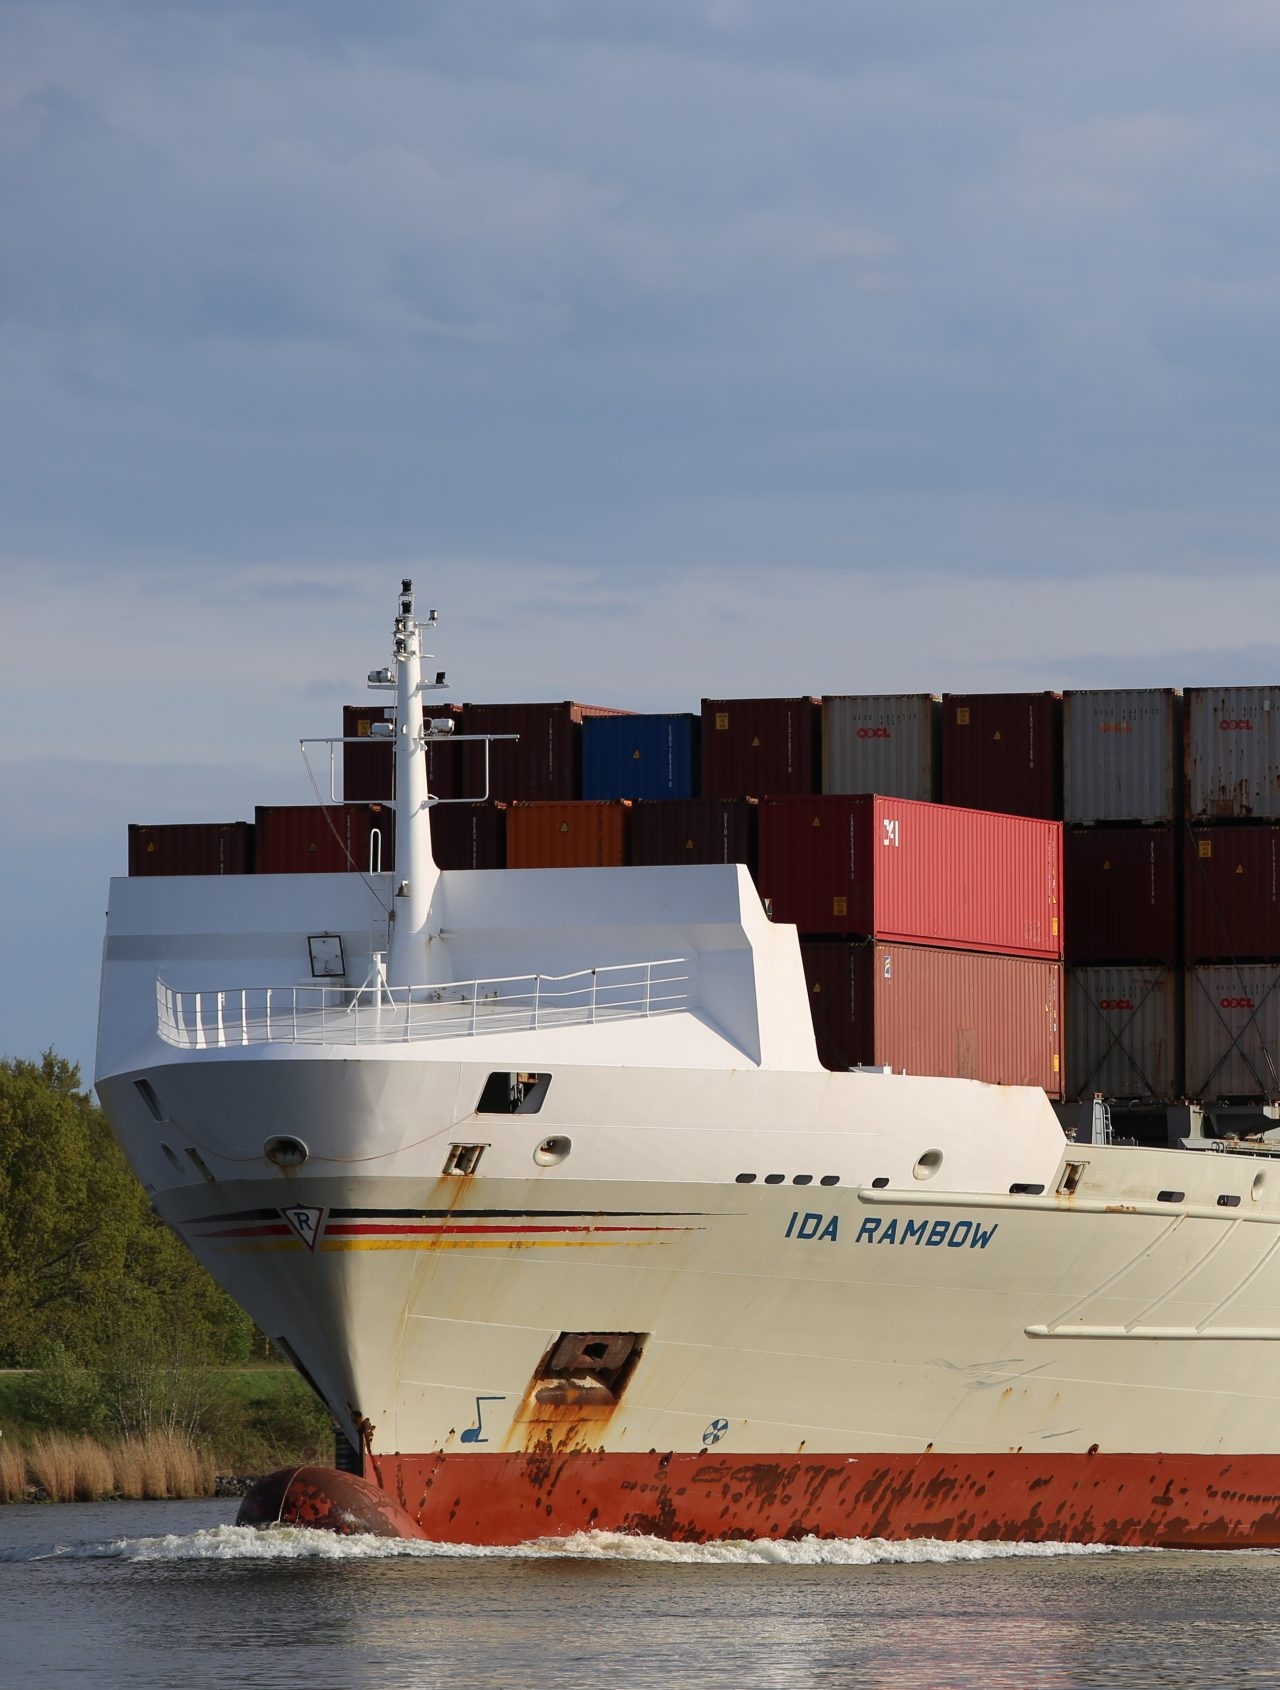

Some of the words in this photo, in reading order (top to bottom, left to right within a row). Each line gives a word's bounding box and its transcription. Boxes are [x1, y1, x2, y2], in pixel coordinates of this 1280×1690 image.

[294, 1211, 313, 1231] R
[785, 1212, 838, 1242] IDA
[855, 1217, 998, 1249] RAMBOW
